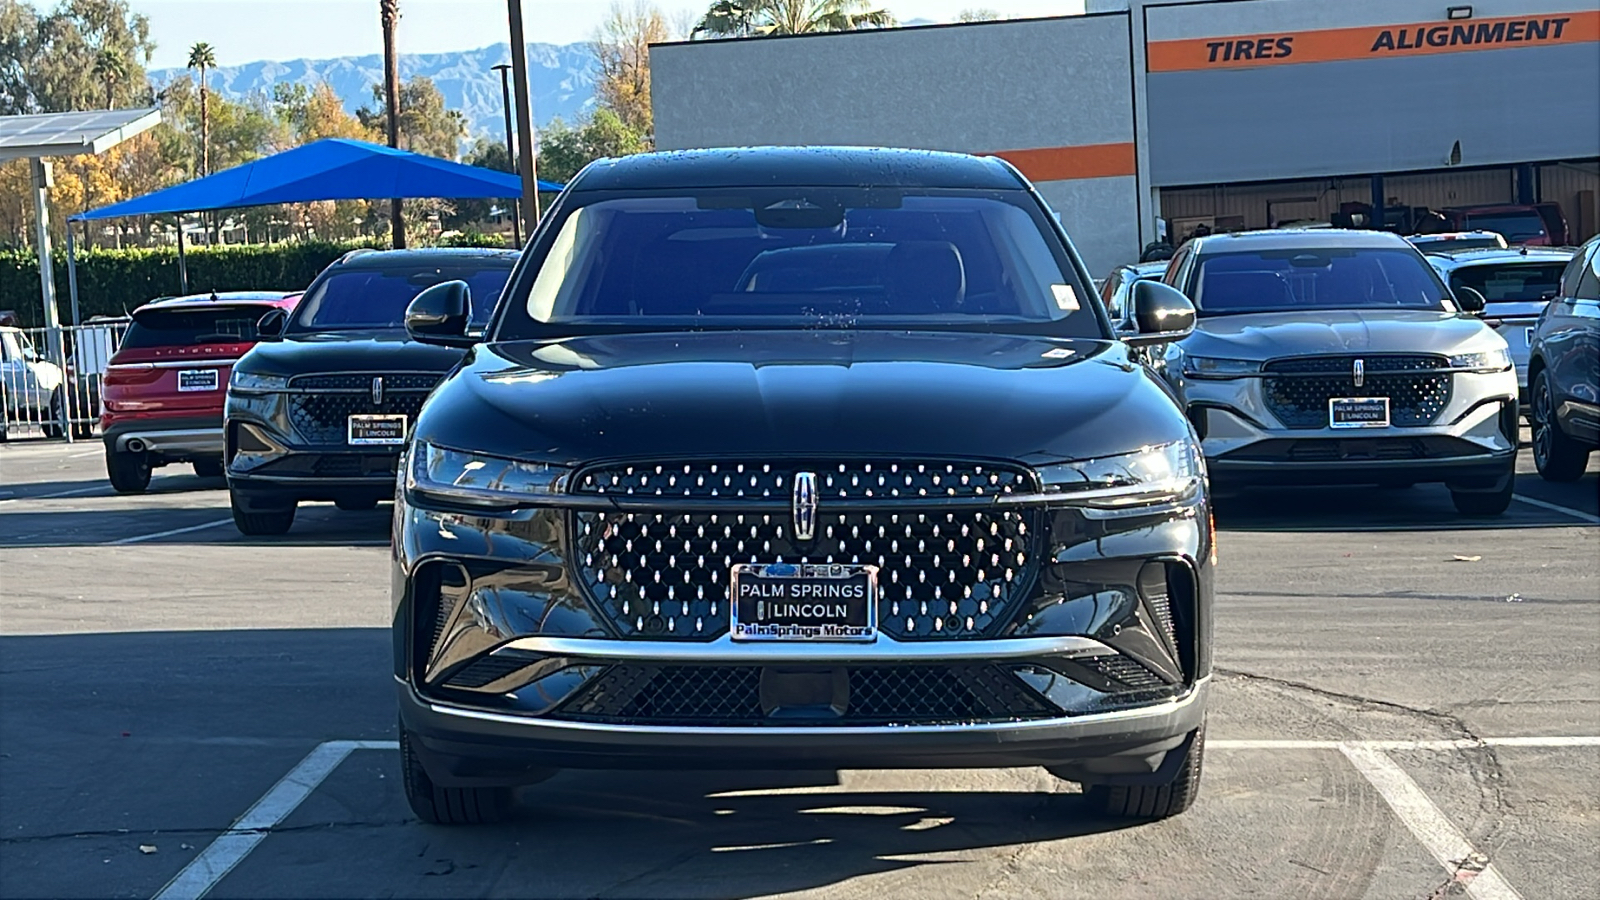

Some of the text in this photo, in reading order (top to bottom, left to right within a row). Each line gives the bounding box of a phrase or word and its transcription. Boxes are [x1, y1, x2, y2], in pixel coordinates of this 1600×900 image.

[1370, 18, 1570, 52] ALIGNMENT
[1206, 37, 1293, 62] TIRES
[740, 584, 864, 598] PALM SPRINGS
[774, 604, 847, 618] LINCOLN
[736, 624, 873, 638] PalmSprings Motors
